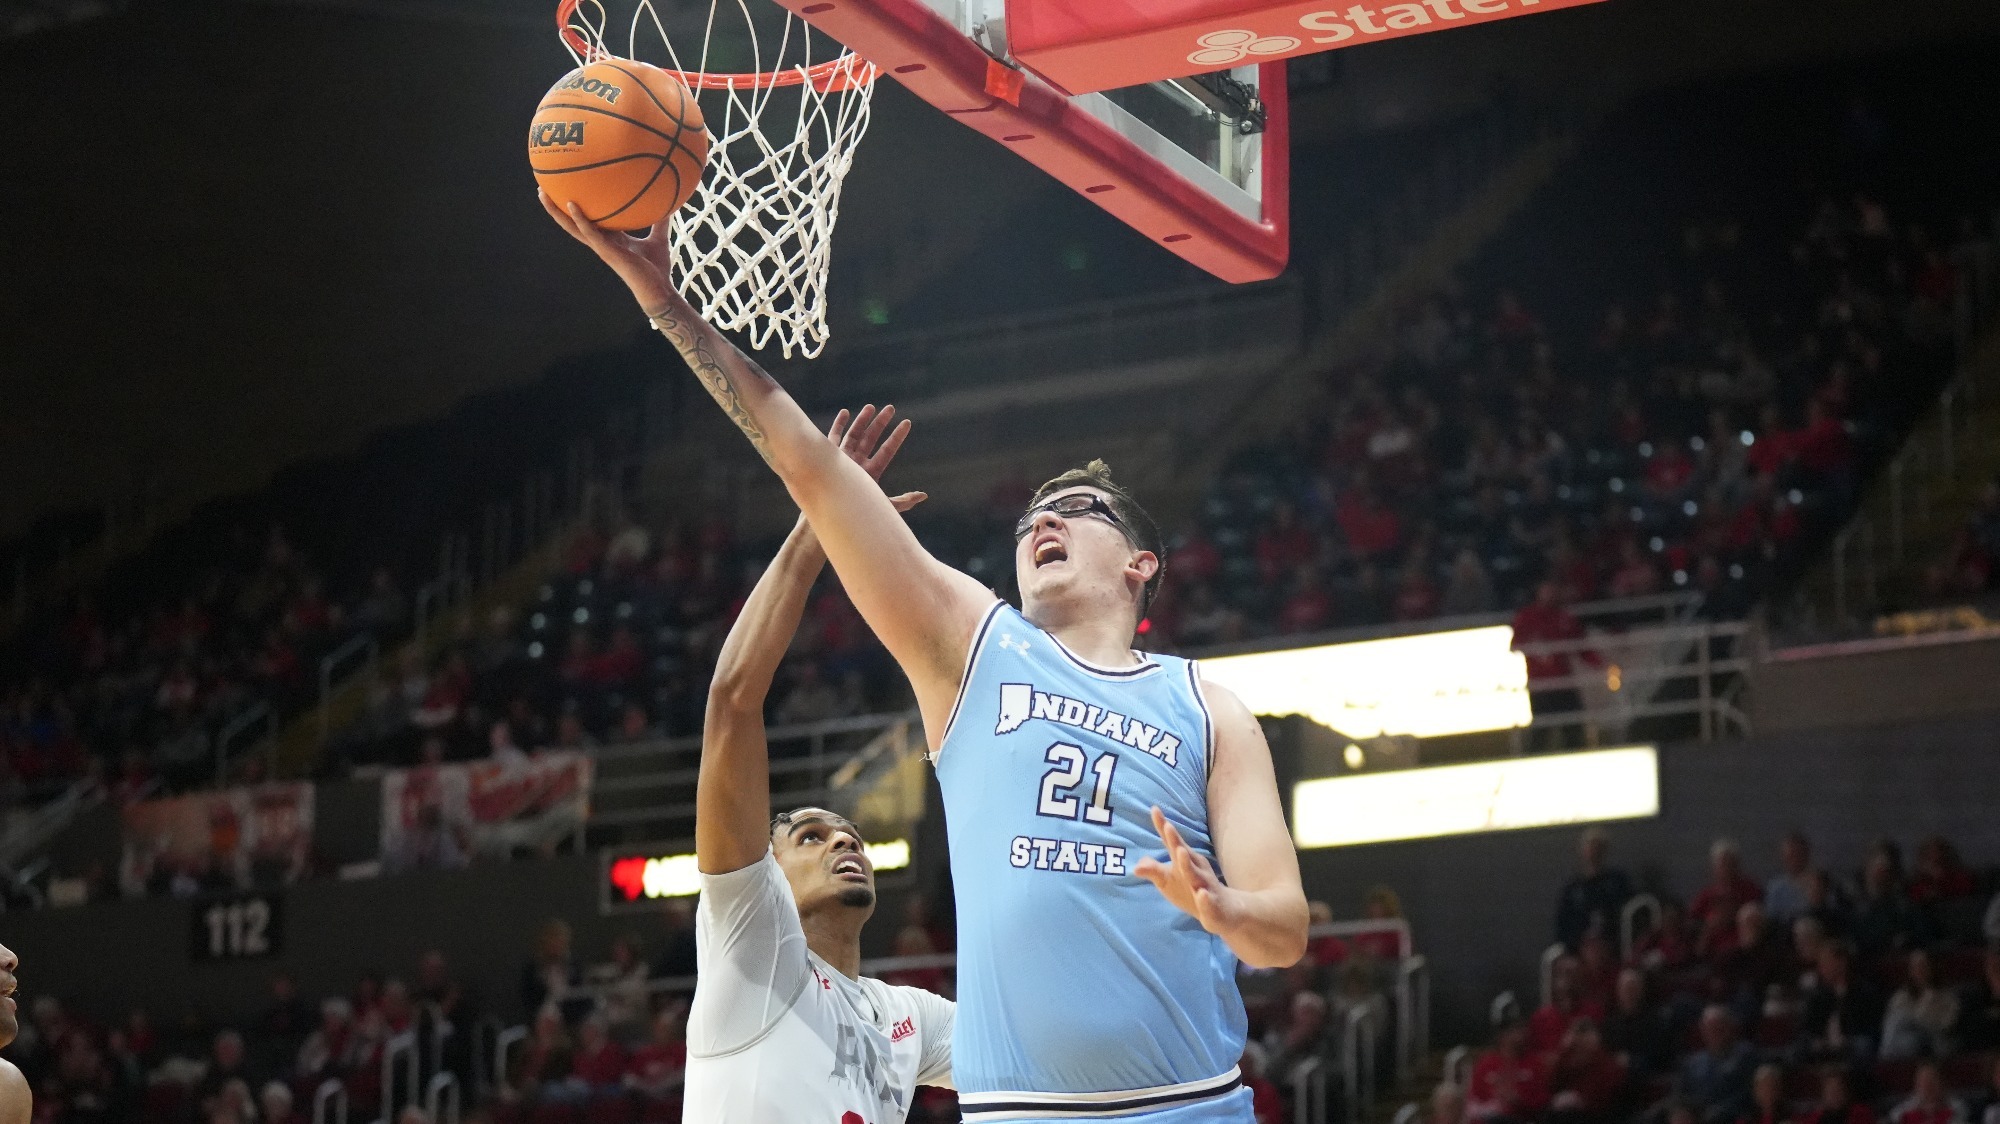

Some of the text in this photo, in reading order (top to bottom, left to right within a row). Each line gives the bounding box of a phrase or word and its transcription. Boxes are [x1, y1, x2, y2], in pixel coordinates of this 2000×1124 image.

[1299, 0, 1540, 43] State
[529, 121, 585, 148] NCAA
[1036, 741, 1119, 826] 21
[1010, 836, 1126, 876] STATE
[206, 902, 270, 955] 112
